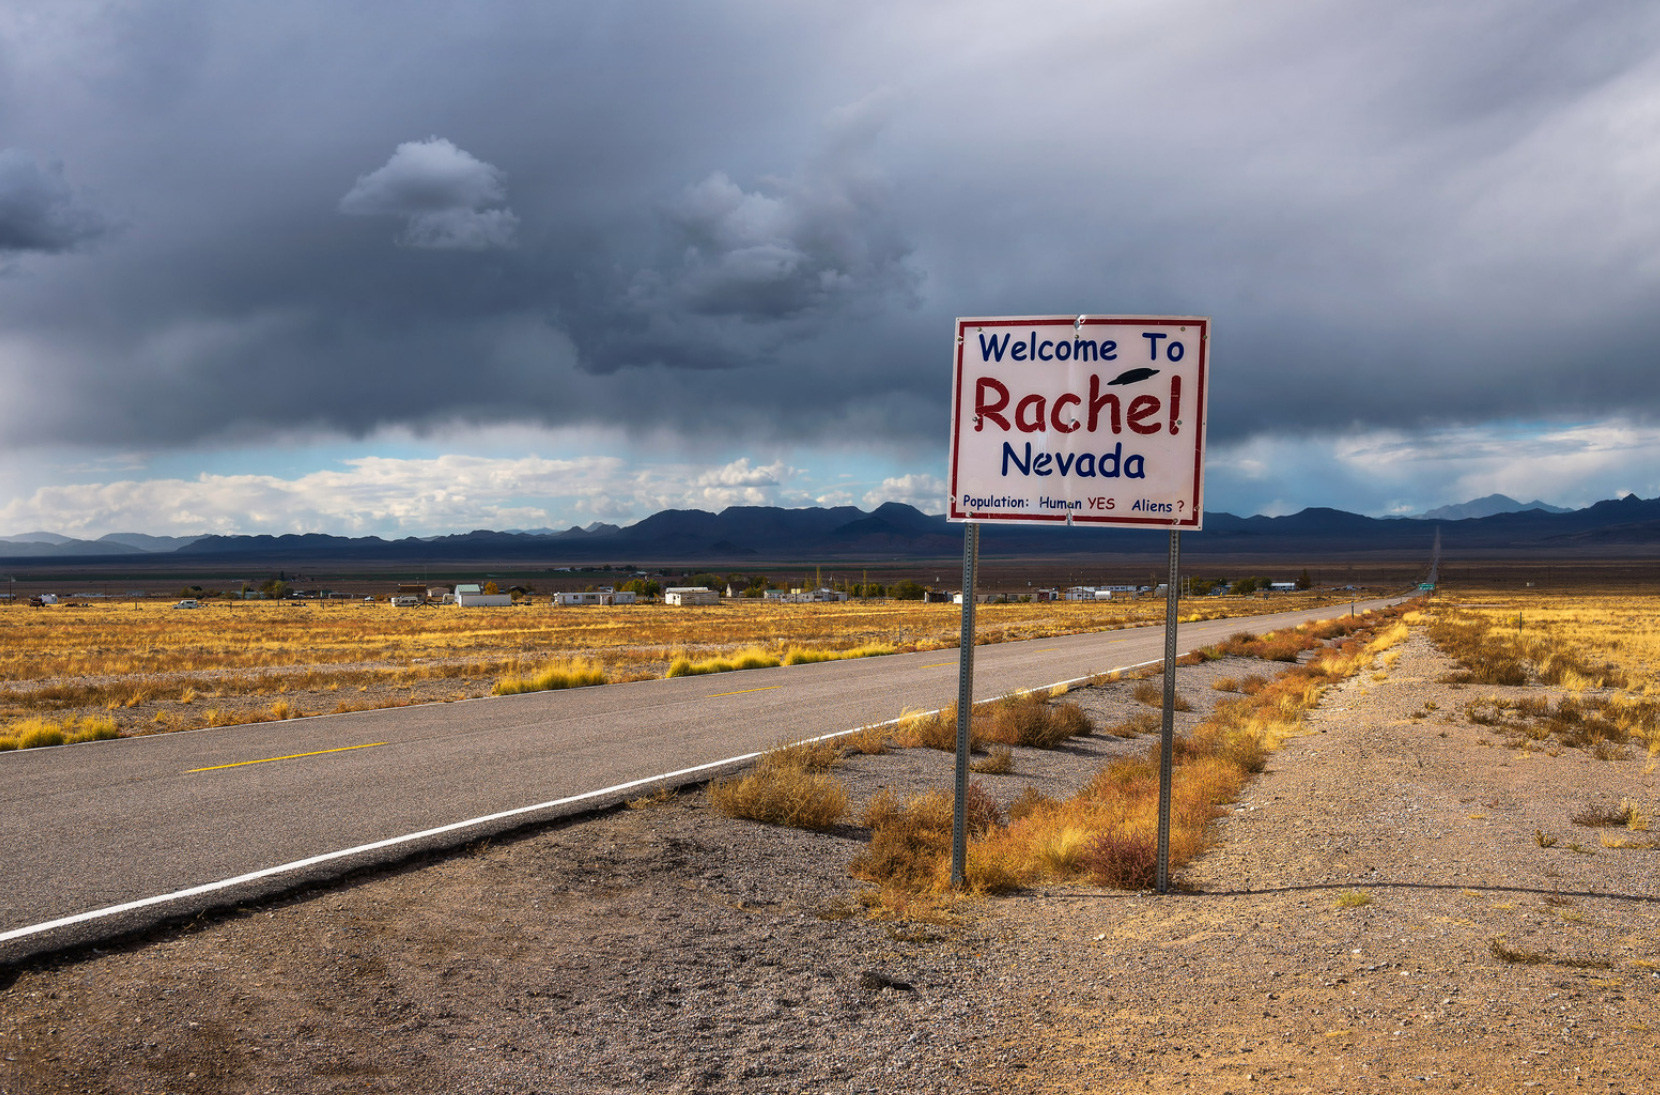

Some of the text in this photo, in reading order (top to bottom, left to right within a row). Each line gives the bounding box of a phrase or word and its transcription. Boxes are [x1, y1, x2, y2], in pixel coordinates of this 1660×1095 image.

[978, 331, 1185, 363] Welcome To
[974, 374, 1183, 436] Rachel
[1001, 441, 1146, 479] Nevada
[963, 494, 1030, 511] Population:
[1087, 497, 1116, 510] YES
[1132, 499, 1173, 513] Aliens
